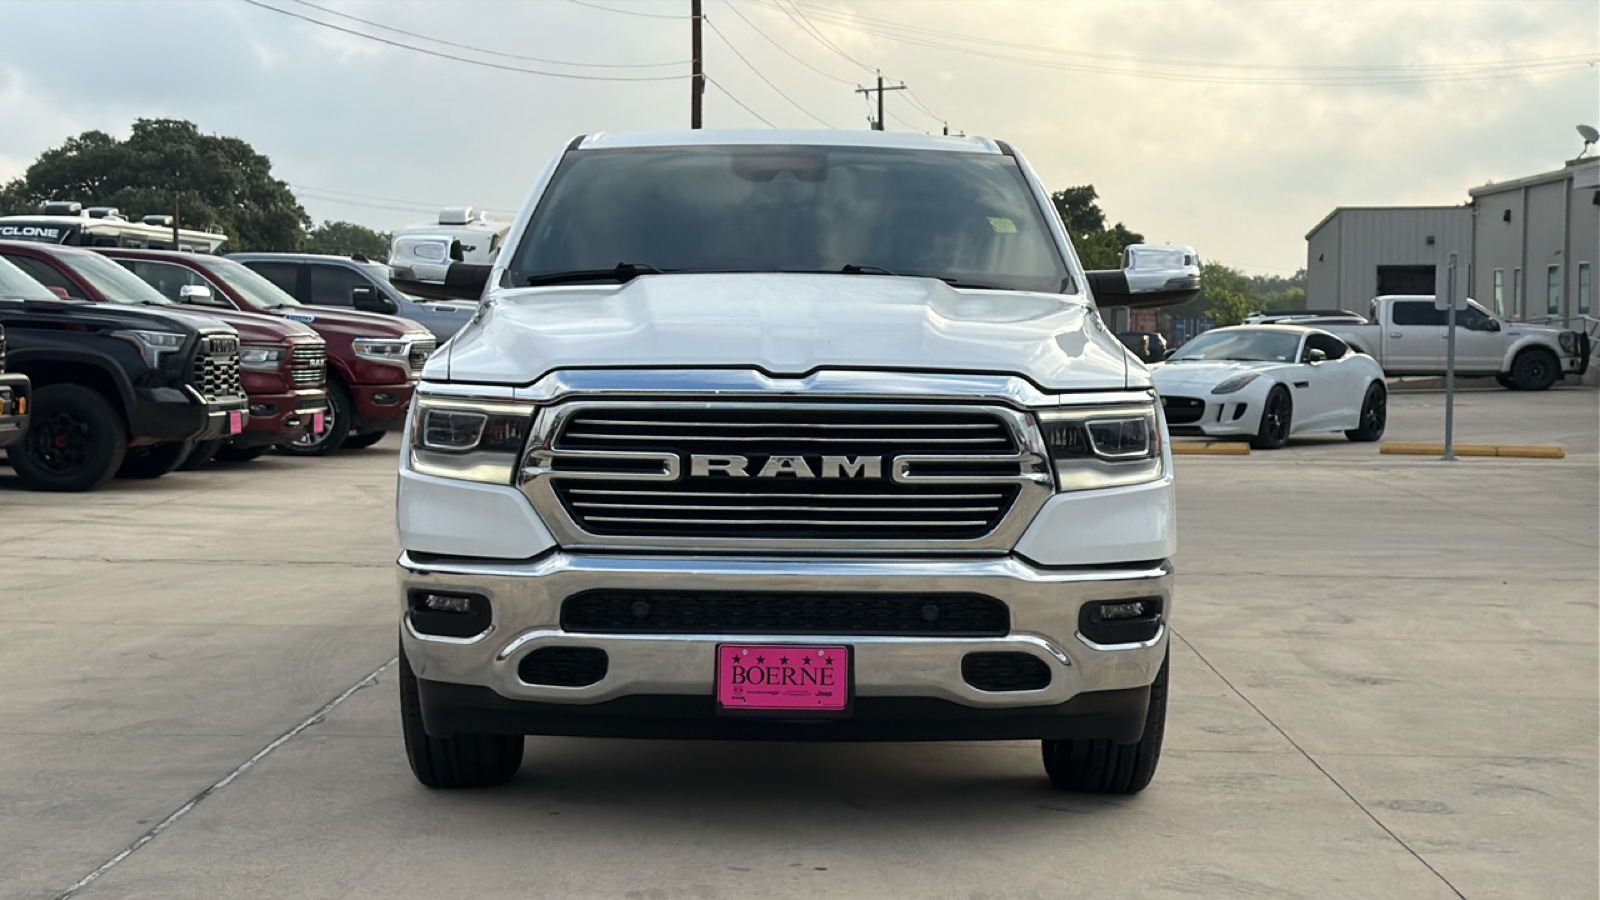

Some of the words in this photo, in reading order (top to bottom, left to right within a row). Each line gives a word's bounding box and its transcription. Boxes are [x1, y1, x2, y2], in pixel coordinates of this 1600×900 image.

[0, 226, 59, 238] CLONE
[690, 454, 882, 478] RAM
[731, 665, 835, 686] BOERNE
